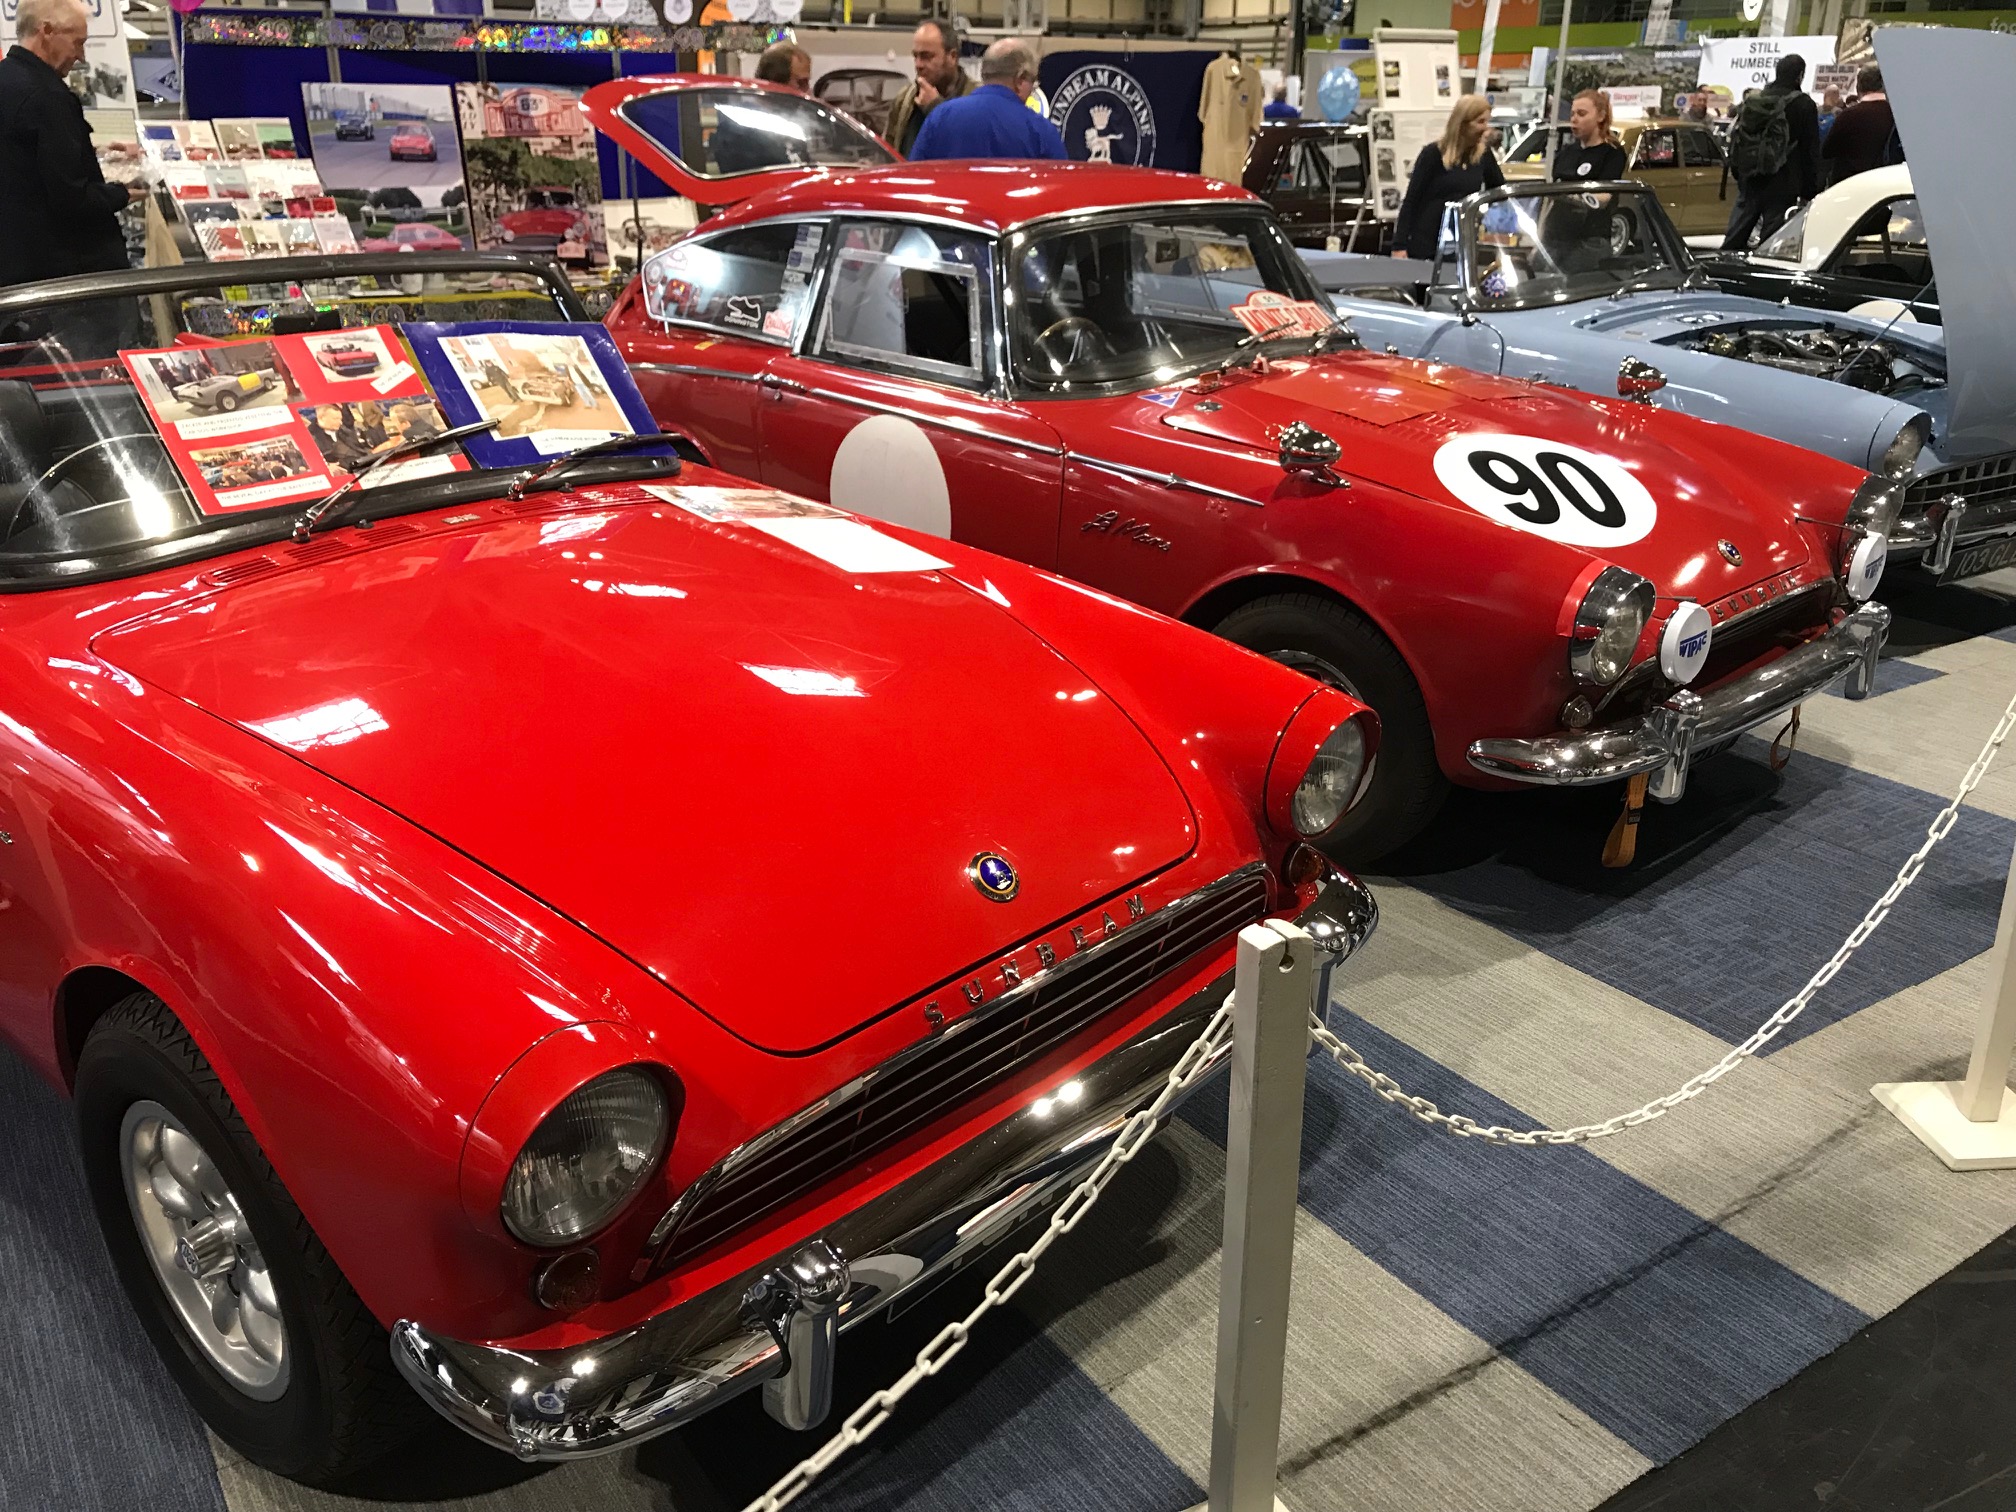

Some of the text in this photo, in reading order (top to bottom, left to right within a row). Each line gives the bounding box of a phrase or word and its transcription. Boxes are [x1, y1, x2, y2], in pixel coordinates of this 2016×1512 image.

[1749, 42, 1780, 54] STILL
[1051, 69, 1152, 137] UNBEAM ALPINE
[1467, 450, 1627, 528] 90
[1953, 547, 1990, 578] 103
[1713, 572, 1798, 619] SUNBEAM
[1679, 631, 1707, 658] WIPAC
[925, 894, 1147, 1028] SUNBEAM
